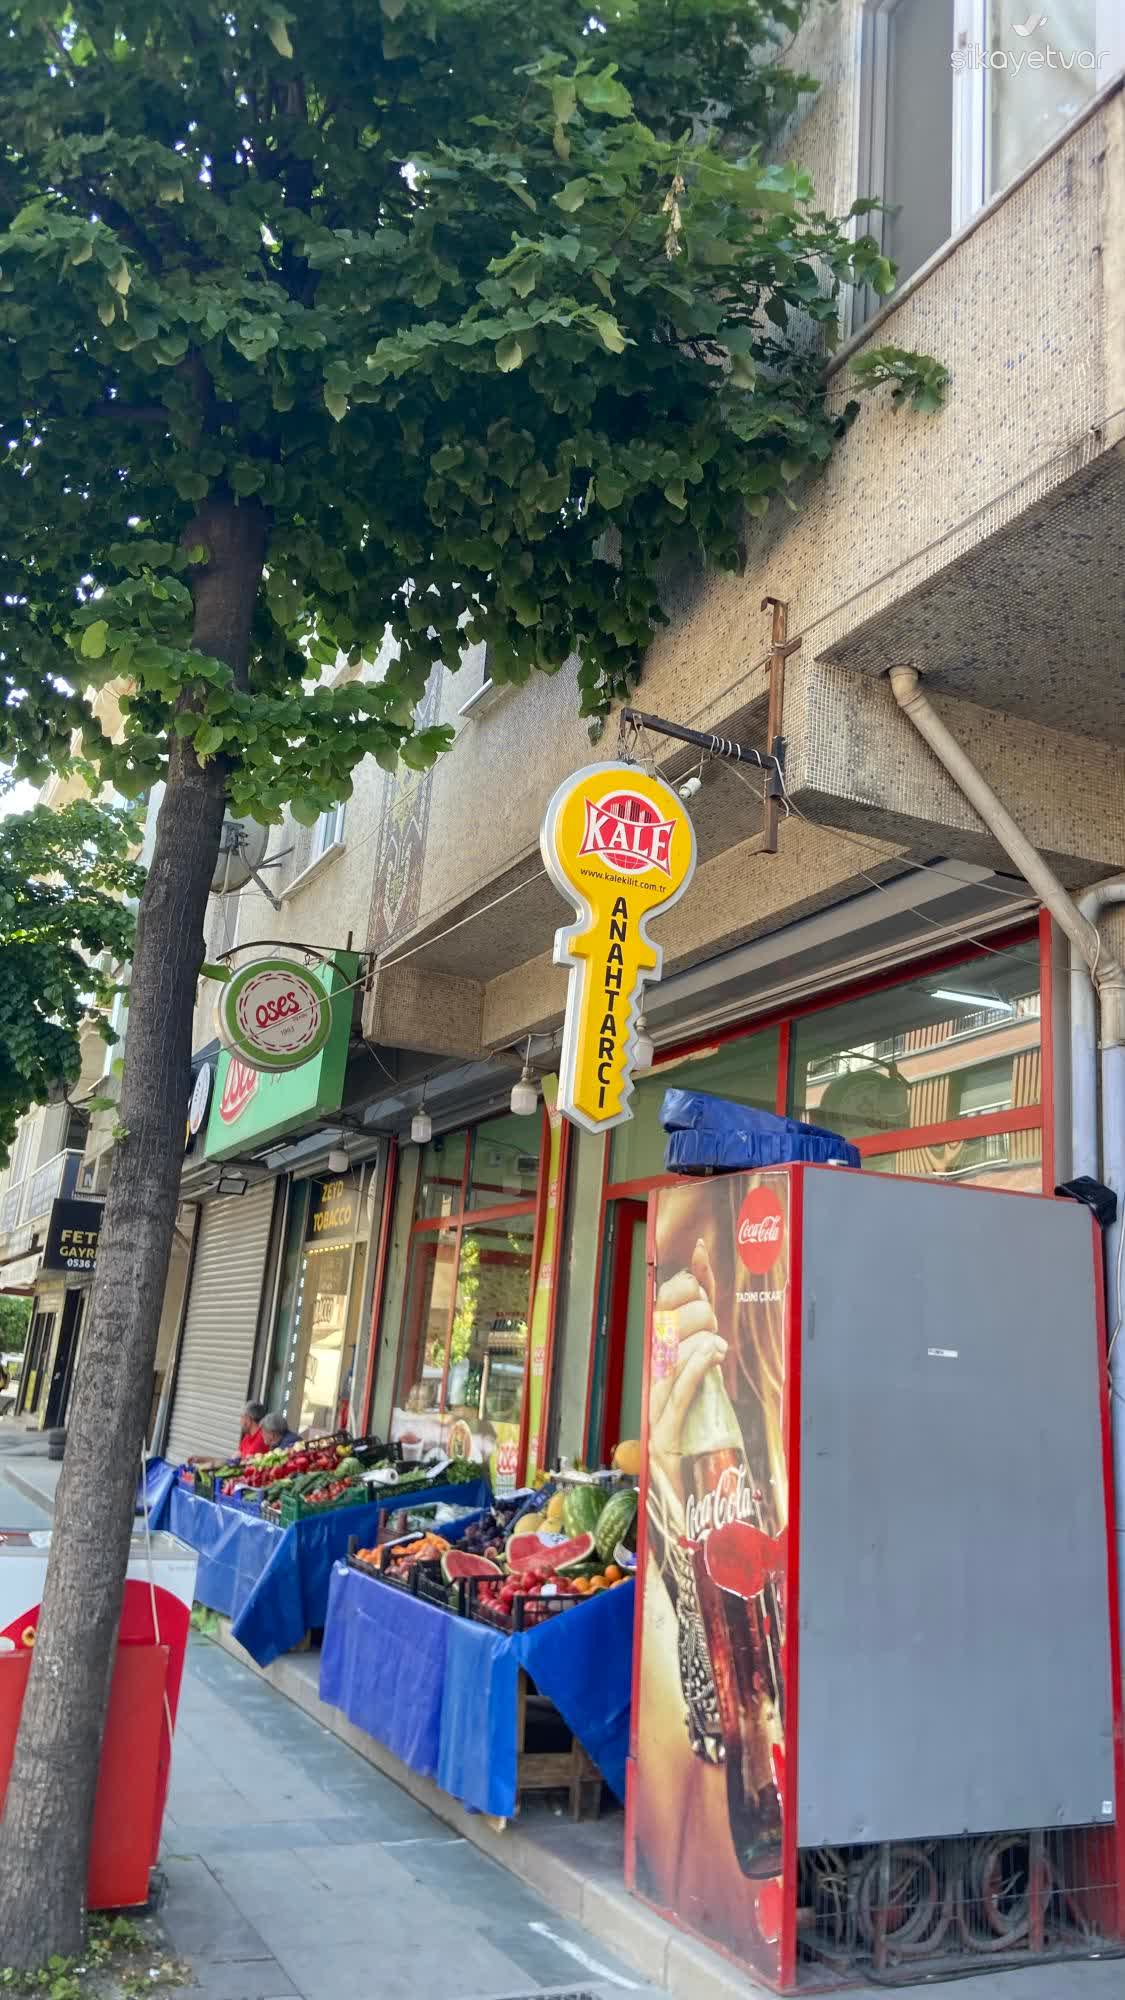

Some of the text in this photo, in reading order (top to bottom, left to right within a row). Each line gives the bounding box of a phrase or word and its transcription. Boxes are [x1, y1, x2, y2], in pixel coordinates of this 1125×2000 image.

[584, 805, 672, 872] KALE
[580, 868, 667, 893] www.kalekilit.com.tr
[598, 896, 628, 1109] ANAHTARCI
[321, 1180, 344, 1203] ZEYD
[313, 1205, 352, 1232] TOBACCO
[59, 1245, 97, 1259] GAYR
[67, 1259, 91, 1269] 0536
